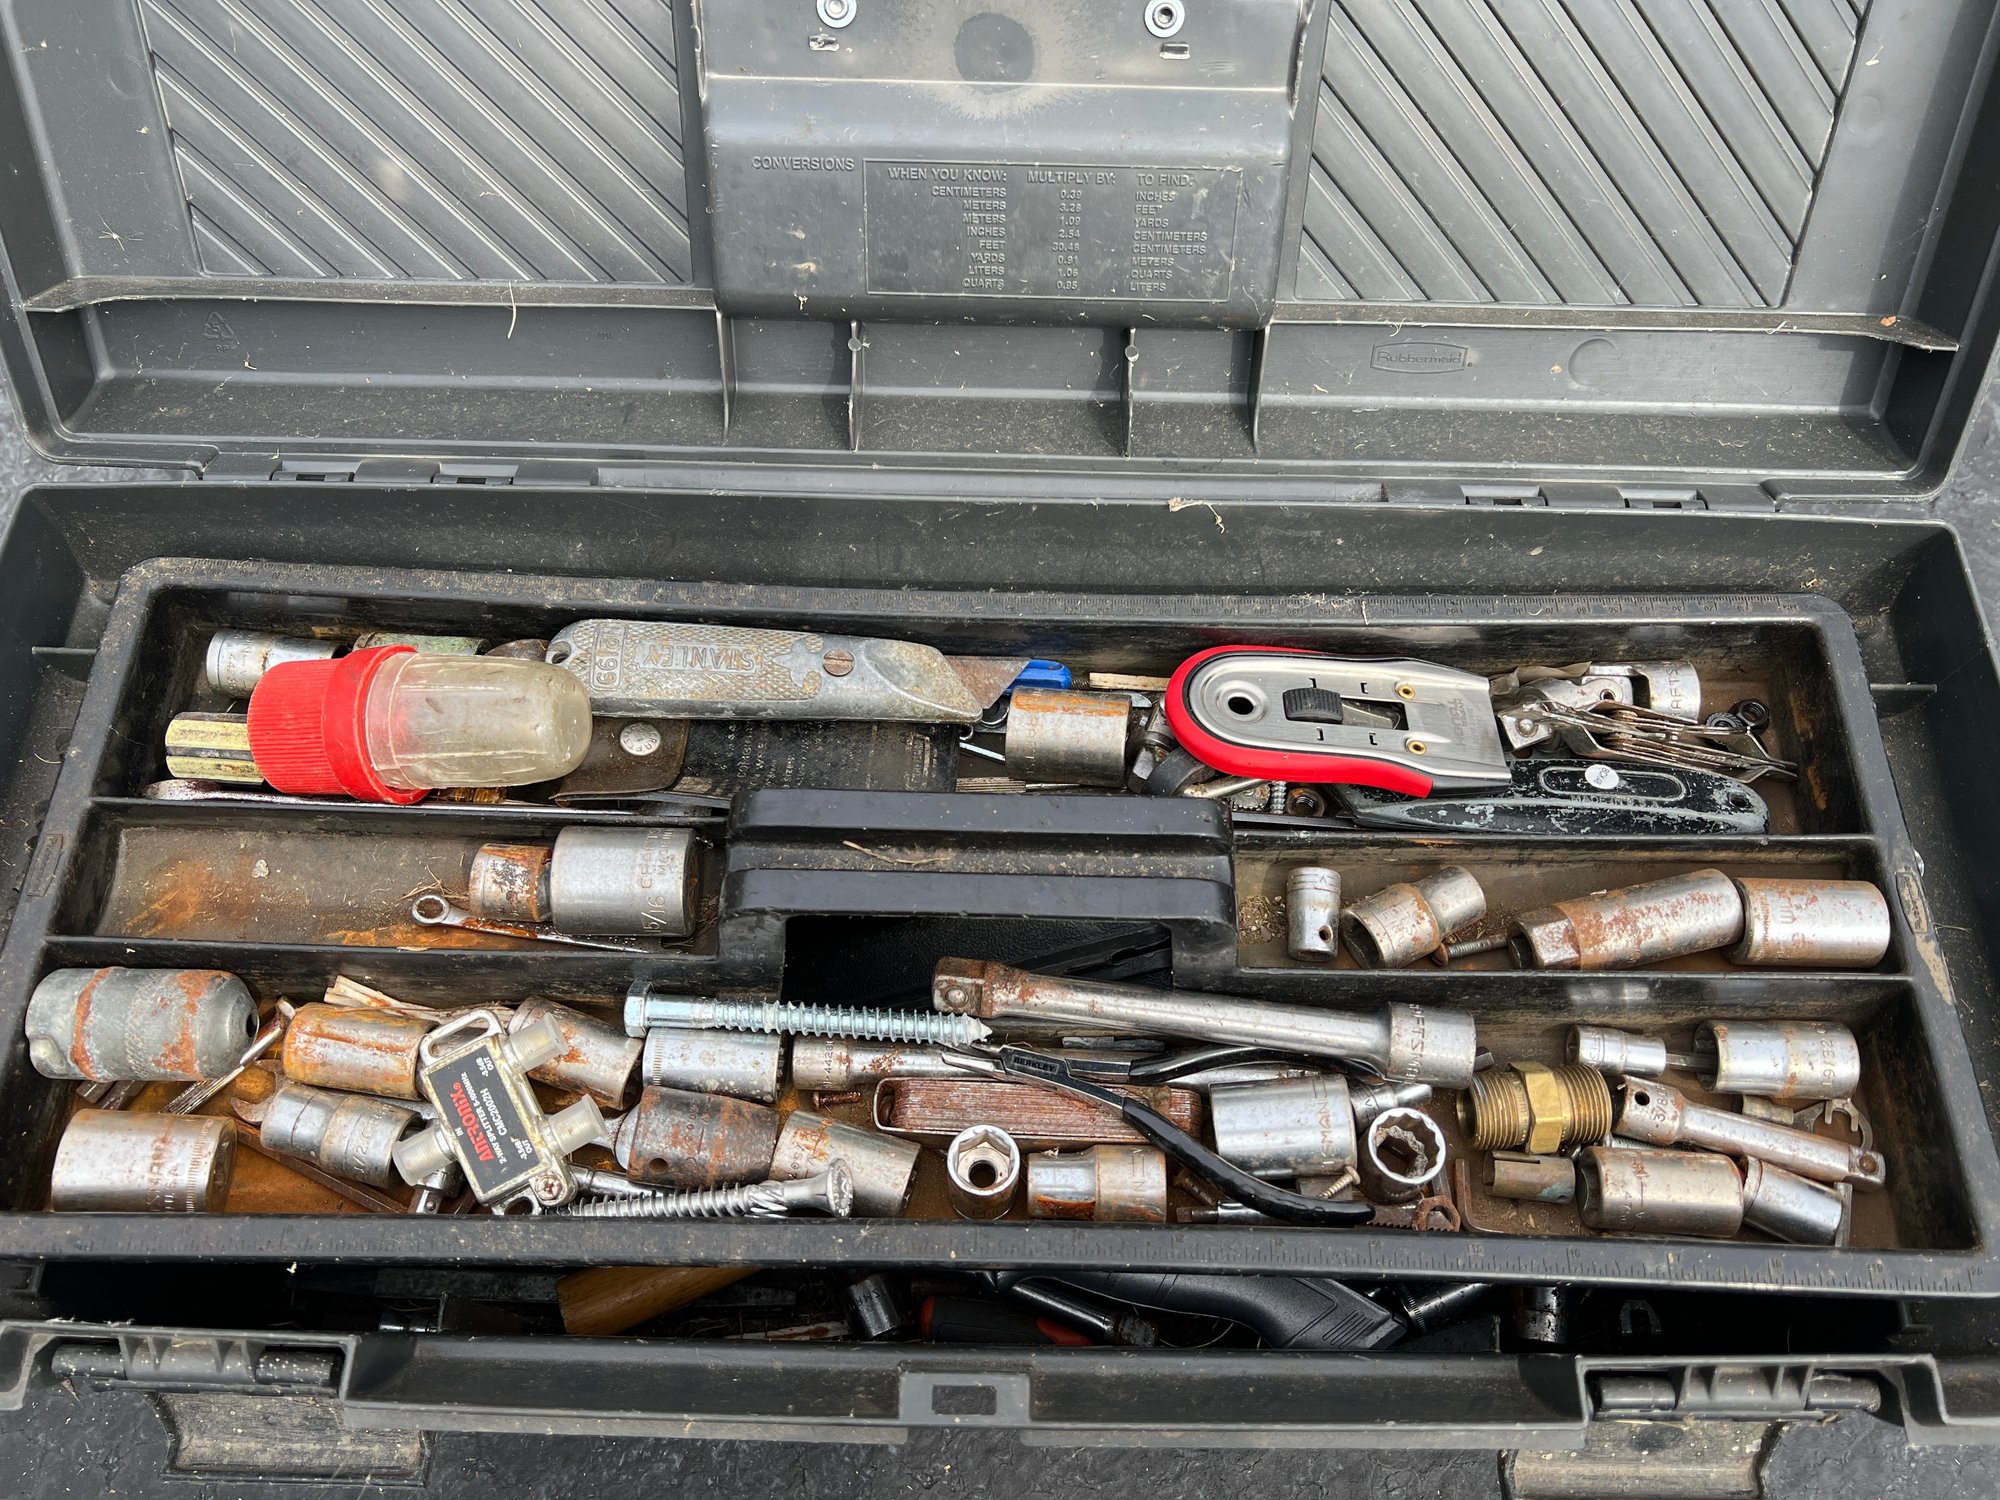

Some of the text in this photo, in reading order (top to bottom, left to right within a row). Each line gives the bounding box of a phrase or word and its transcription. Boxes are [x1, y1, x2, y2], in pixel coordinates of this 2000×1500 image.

[751, 156, 855, 171] CONVERSIONS
[888, 167, 1007, 182] WHEN YOU KNOW:
[1027, 170, 1116, 185] MULTIPLY BY:
[1137, 173, 1196, 187] TO FIND:
[931, 186, 1007, 197] CENTIMETERS
[1059, 189, 1082, 200] 0.39
[1135, 191, 1177, 202] INCHES
[963, 199, 1007, 211] METERS
[1059, 202, 1082, 213] 3.28
[1134, 204, 1163, 215] FEET
[962, 213, 1006, 224] METERS
[1059, 216, 1081, 226] 1.09
[1134, 217, 1169, 228] YARDS
[966, 226, 1006, 237] INCHES
[1058, 229, 1081, 239] 2.54
[1133, 231, 1208, 242] CENTIMETERS
[979, 240, 1006, 250] FEET
[1052, 241, 1080, 252] 30.48
[1132, 243, 1207, 255] CENTIMETERS
[971, 252, 1005, 263] YARDS
[1057, 255, 1079, 265] 0.91
[1131, 257, 1174, 268] METERS
[968, 265, 1005, 276] LITERS
[1057, 268, 1079, 278] 1.06
[1131, 269, 1173, 280] QUARTS
[962, 277, 1005, 290] QUARTS
[1056, 280, 1078, 290] 0.95
[1130, 281, 1167, 292] LITERS
[1377, 351, 1462, 364] Rubbermaid
[643, 644, 755, 671] STANLEY
[483, 1057, 494, 1070] OUT
[1013, 1055, 1056, 1073] BERKLEY
[480, 1088, 507, 1136] CMC2002H
[476, 1106, 497, 1142] SPLITTER
[522, 1139, 533, 1154] OUT
